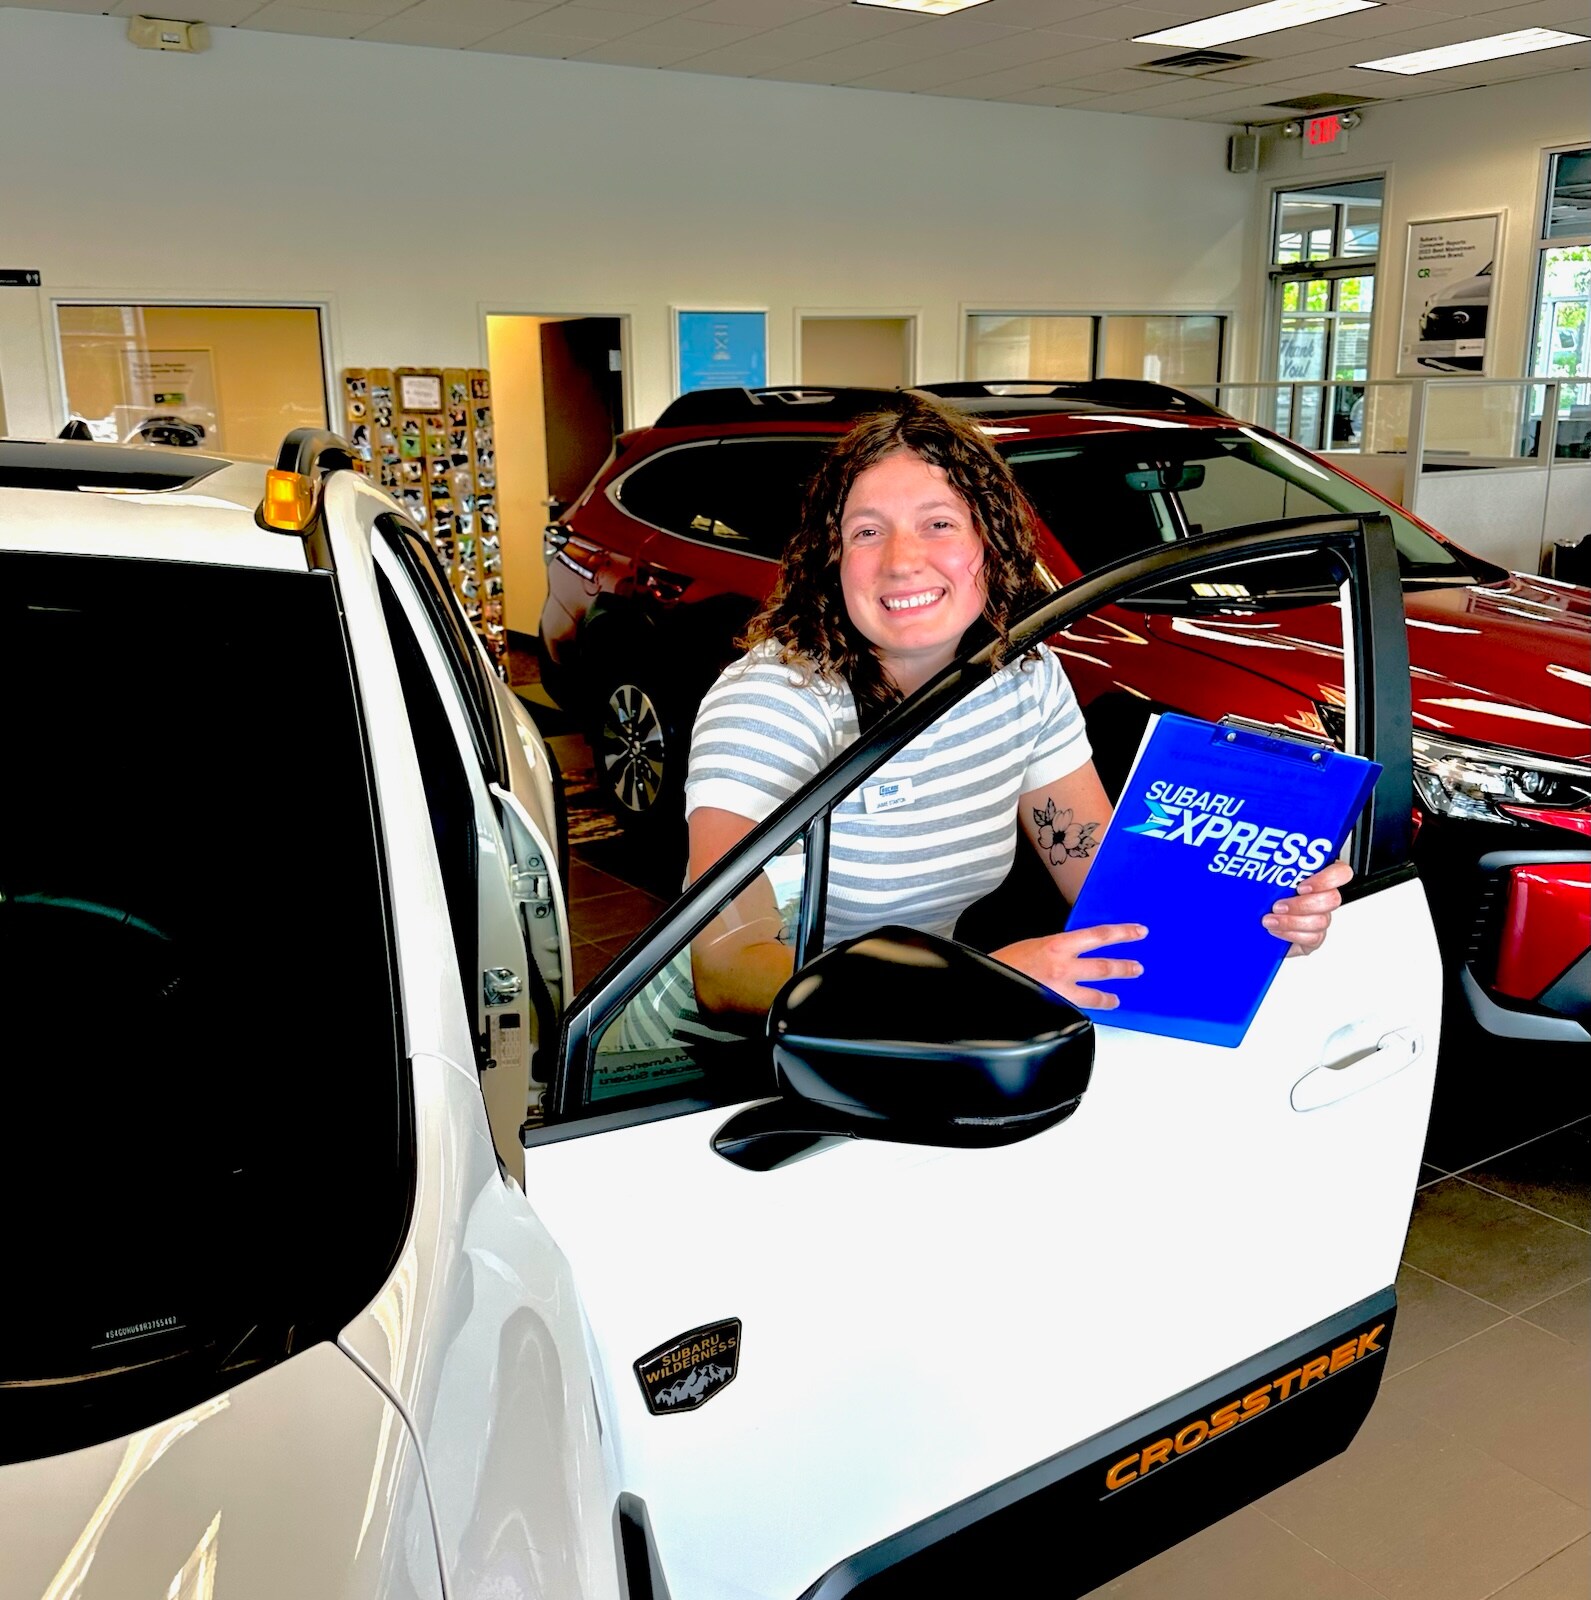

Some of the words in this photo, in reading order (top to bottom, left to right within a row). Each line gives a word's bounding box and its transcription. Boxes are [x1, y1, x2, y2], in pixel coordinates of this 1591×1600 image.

[1309, 116, 1338, 145] EXIT
[1417, 268, 1430, 278] CR
[1279, 338, 1315, 358] Thank
[1282, 359, 1312, 378] You!
[1145, 780, 1246, 817] SUBARU
[1122, 799, 1333, 871] EXPRESS
[646, 1337, 737, 1384] WILDERNESS
[661, 1334, 720, 1367] SUBARU
[1105, 1323, 1385, 1491] CROSSTREK
